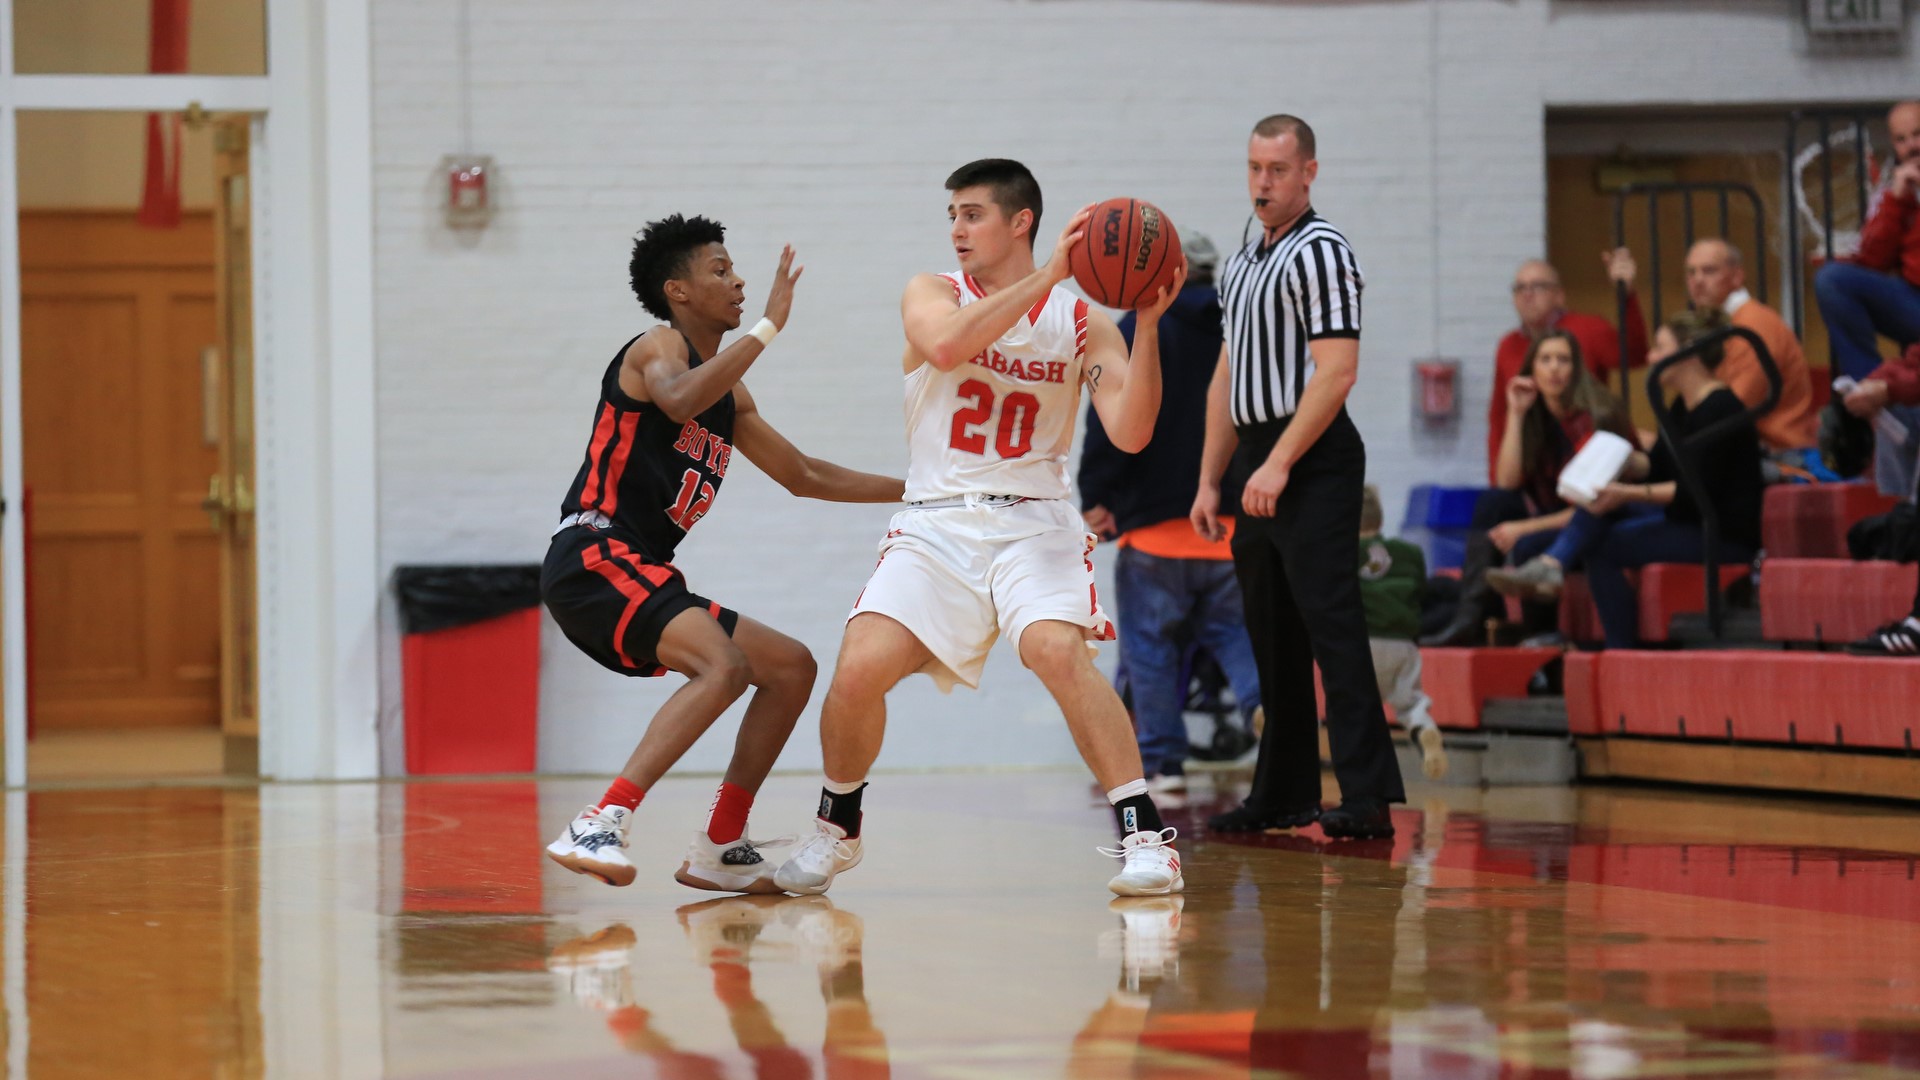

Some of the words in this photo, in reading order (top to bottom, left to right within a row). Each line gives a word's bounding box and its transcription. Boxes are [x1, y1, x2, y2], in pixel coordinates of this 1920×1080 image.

[1103, 207, 1122, 257] NCAA
[1133, 204, 1160, 272] Wilson
[968, 348, 1067, 384] ABASH
[949, 377, 1040, 459] 20
[664, 467, 716, 533] 12
